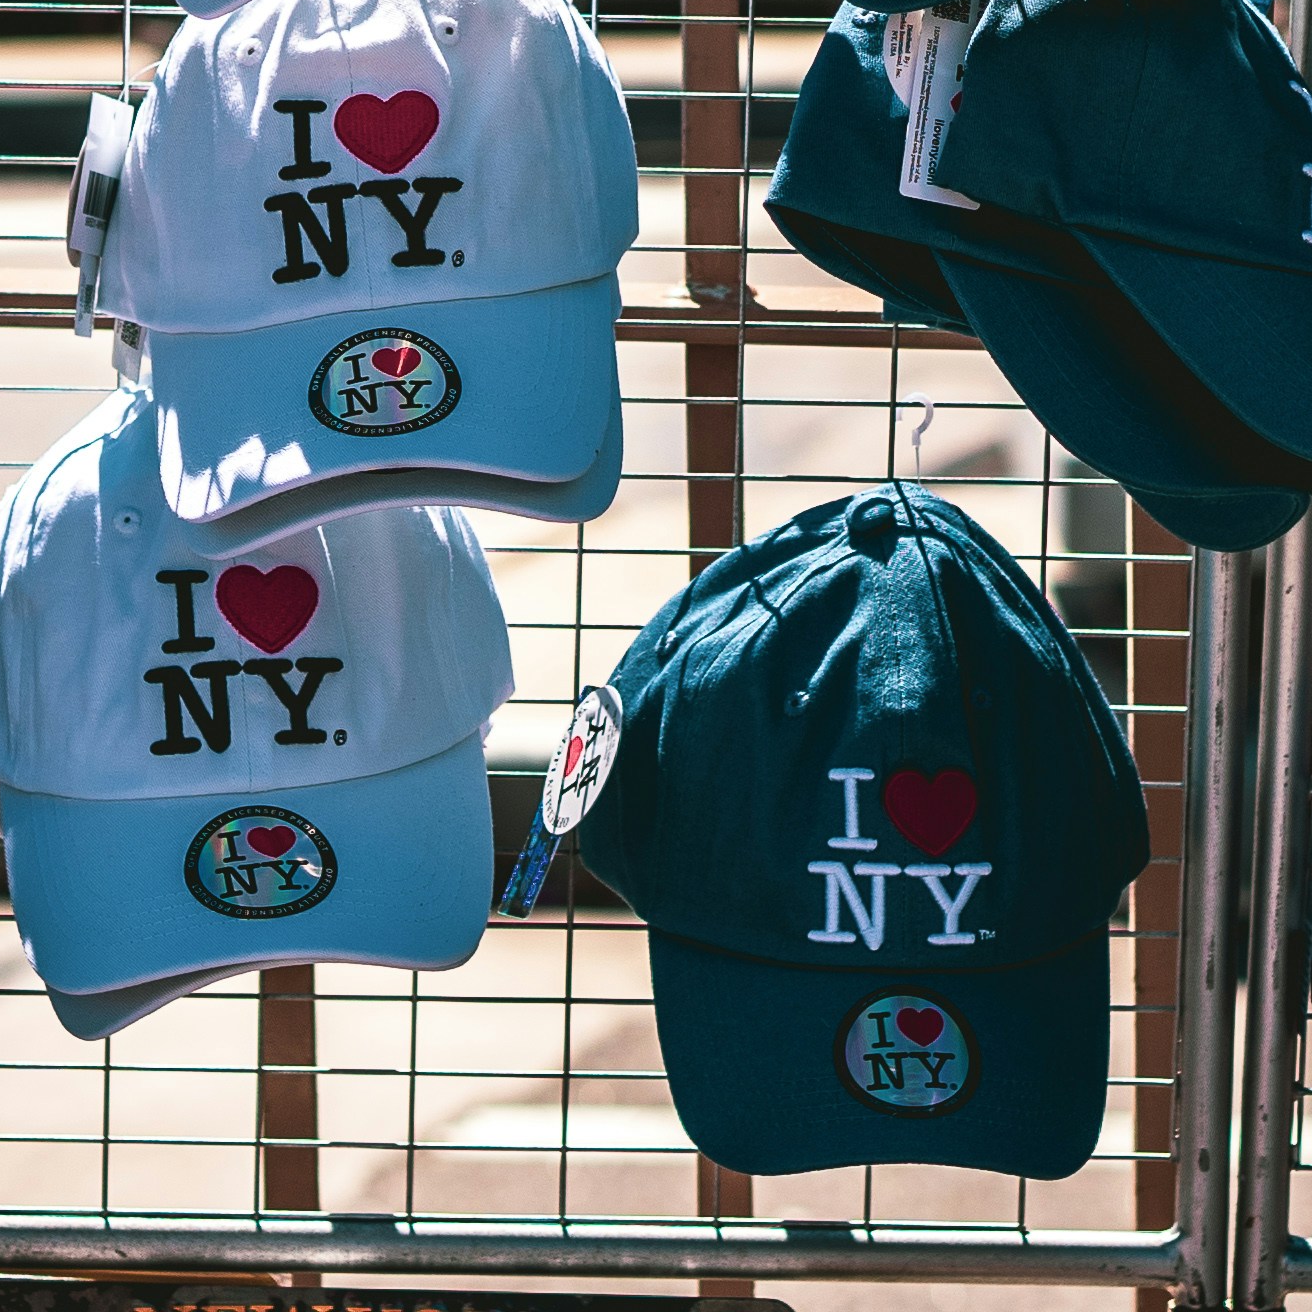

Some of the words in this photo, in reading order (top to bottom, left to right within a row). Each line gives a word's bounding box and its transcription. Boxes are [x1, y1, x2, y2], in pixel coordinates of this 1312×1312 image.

[273, 100, 332, 180] I
[343, 352, 370, 385] I
[354, 330, 412, 343] LICENSED
[416, 337, 454, 373] PRODUCT
[155, 570, 215, 654] I
[227, 808, 285, 819] LICENSED
[289, 815, 329, 852] PRODUCT
[828, 768, 877, 850] I
[218, 830, 247, 863] I
[867, 1011, 895, 1049] I
